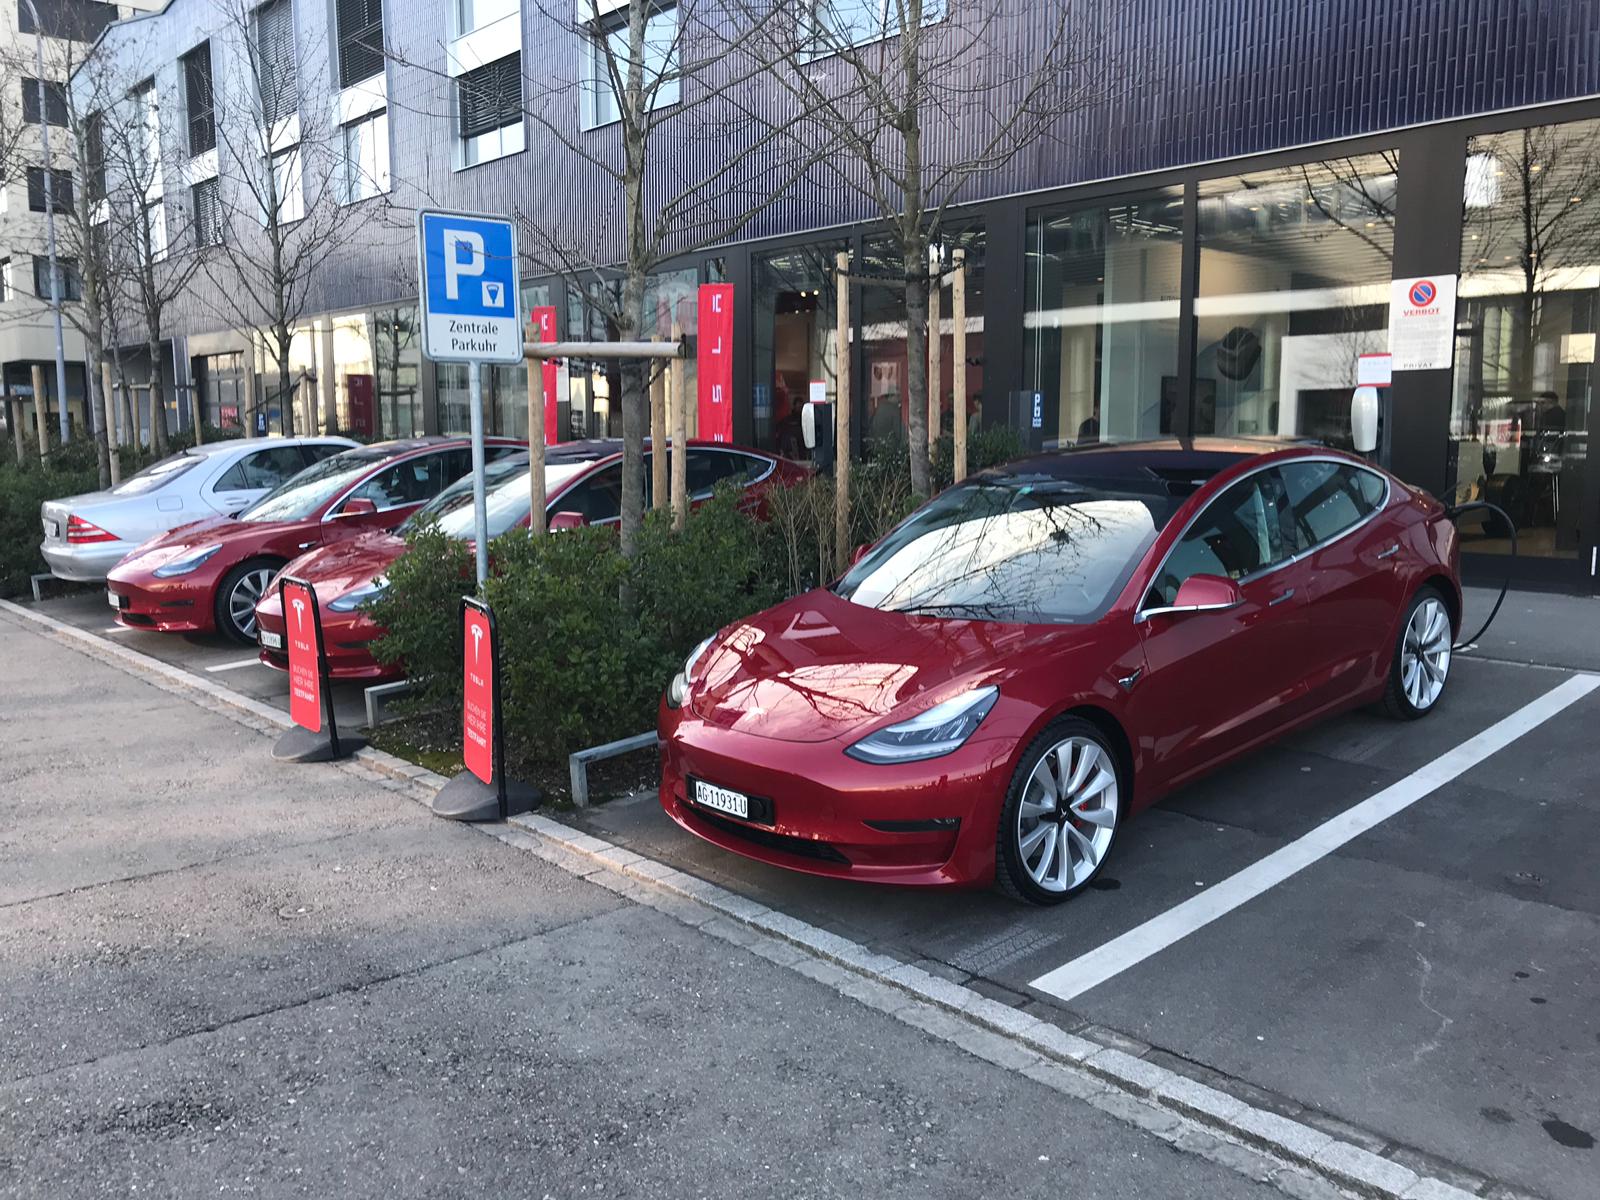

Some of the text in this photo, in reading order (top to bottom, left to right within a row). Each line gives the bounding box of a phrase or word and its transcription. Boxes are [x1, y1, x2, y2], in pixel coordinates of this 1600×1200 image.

[443, 228, 486, 300] P
[449, 319, 499, 335] Zentrale
[451, 337, 498, 353] Parkuhr
